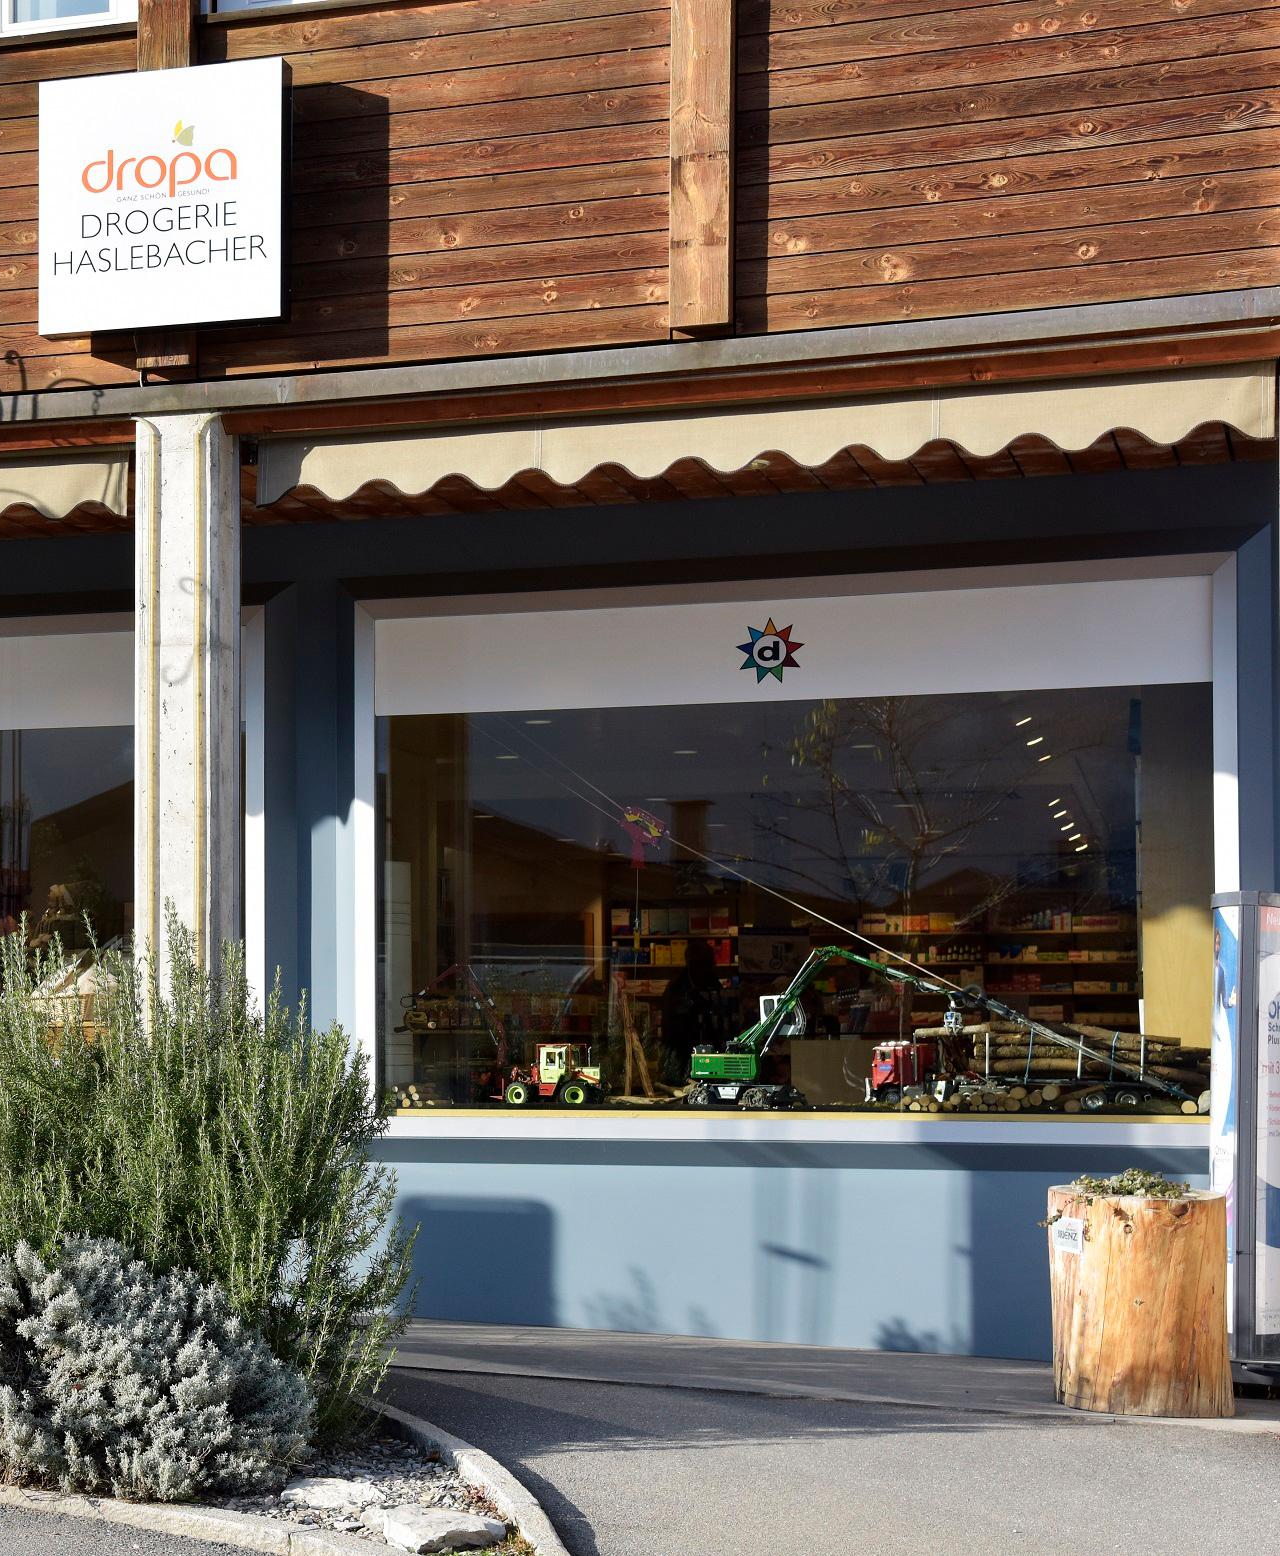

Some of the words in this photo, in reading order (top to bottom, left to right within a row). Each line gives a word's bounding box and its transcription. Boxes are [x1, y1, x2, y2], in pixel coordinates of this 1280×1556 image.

[82, 148, 238, 198] dropa
[140, 191, 167, 200] SCHÖN
[82, 201, 237, 238] DROGERIE
[54, 234, 268, 276] HASLEBACHER
[758, 641, 779, 661] d
